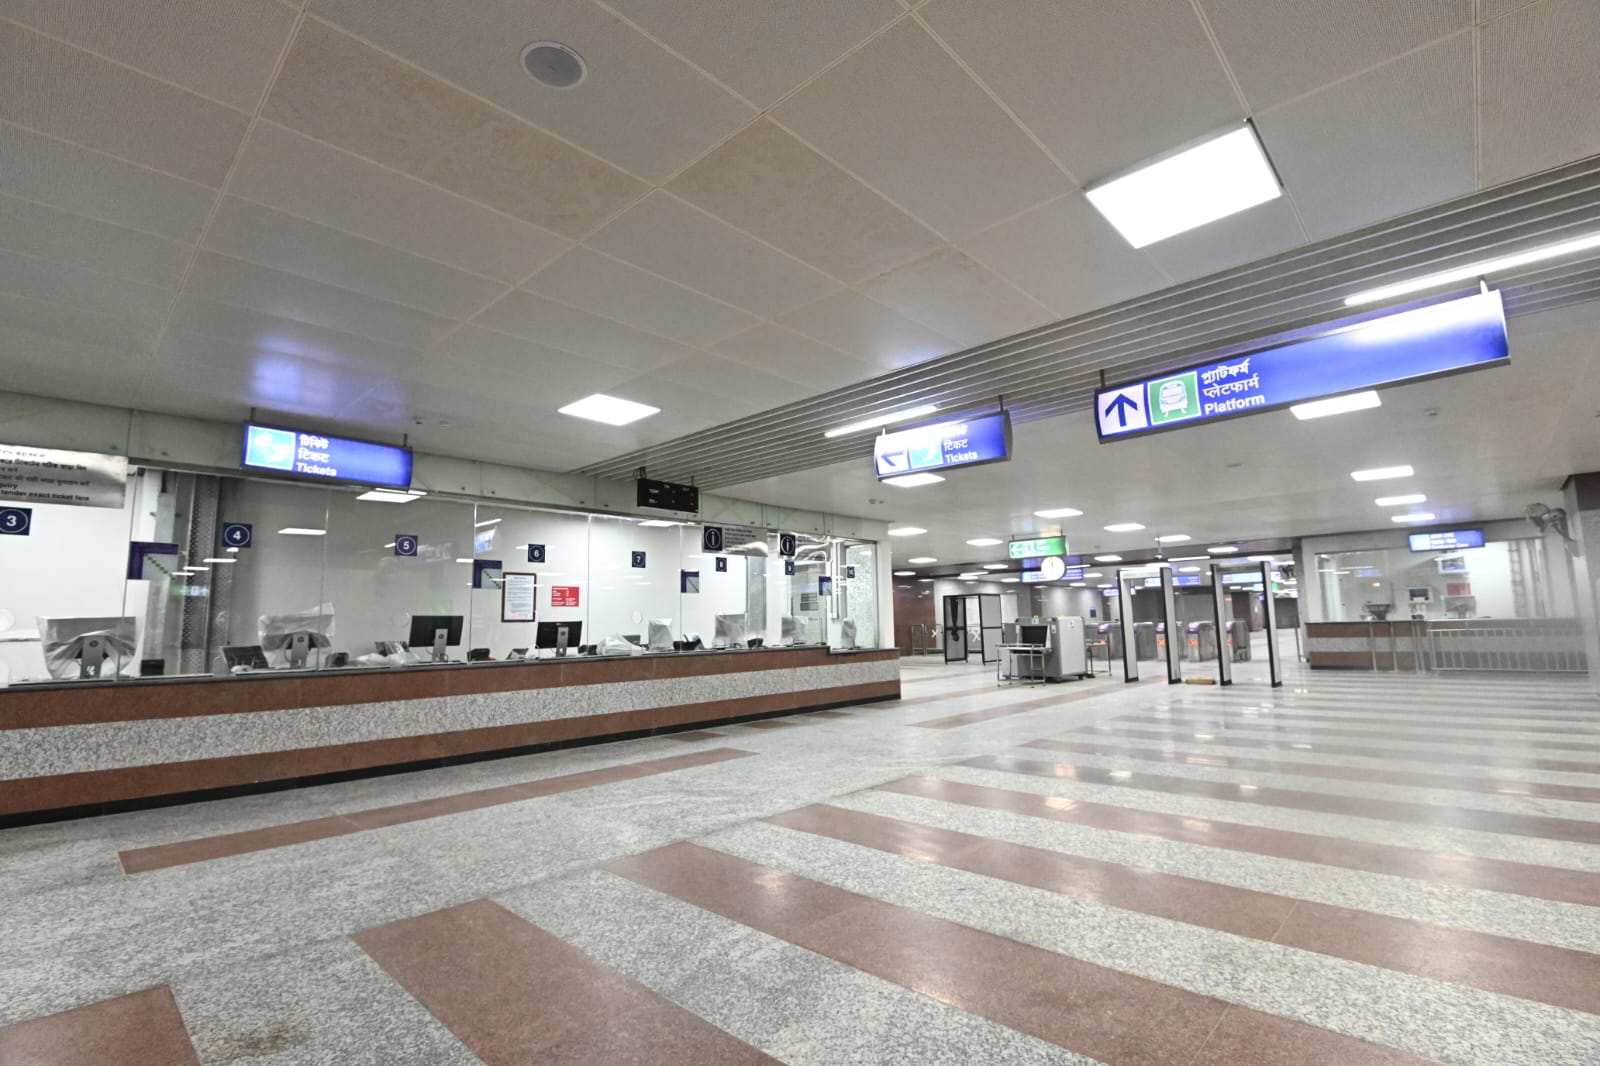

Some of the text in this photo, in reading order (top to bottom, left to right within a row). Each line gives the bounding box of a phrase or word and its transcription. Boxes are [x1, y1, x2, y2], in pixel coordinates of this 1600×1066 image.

[1204, 395, 1265, 415] Platform
[943, 438, 969, 452] टिकट
[298, 447, 331, 463] टिकट
[944, 451, 978, 463] Tickets
[296, 462, 337, 477] Tickets
[1, 489, 27, 498] tender
[29, 491, 50, 499] exact
[52, 493, 73, 501] ticket
[6, 515, 17, 527] 3
[232, 530, 241, 541] 4
[403, 541, 410, 550] 5
[533, 549, 540, 558] 6
[635, 555, 641, 563] 7
